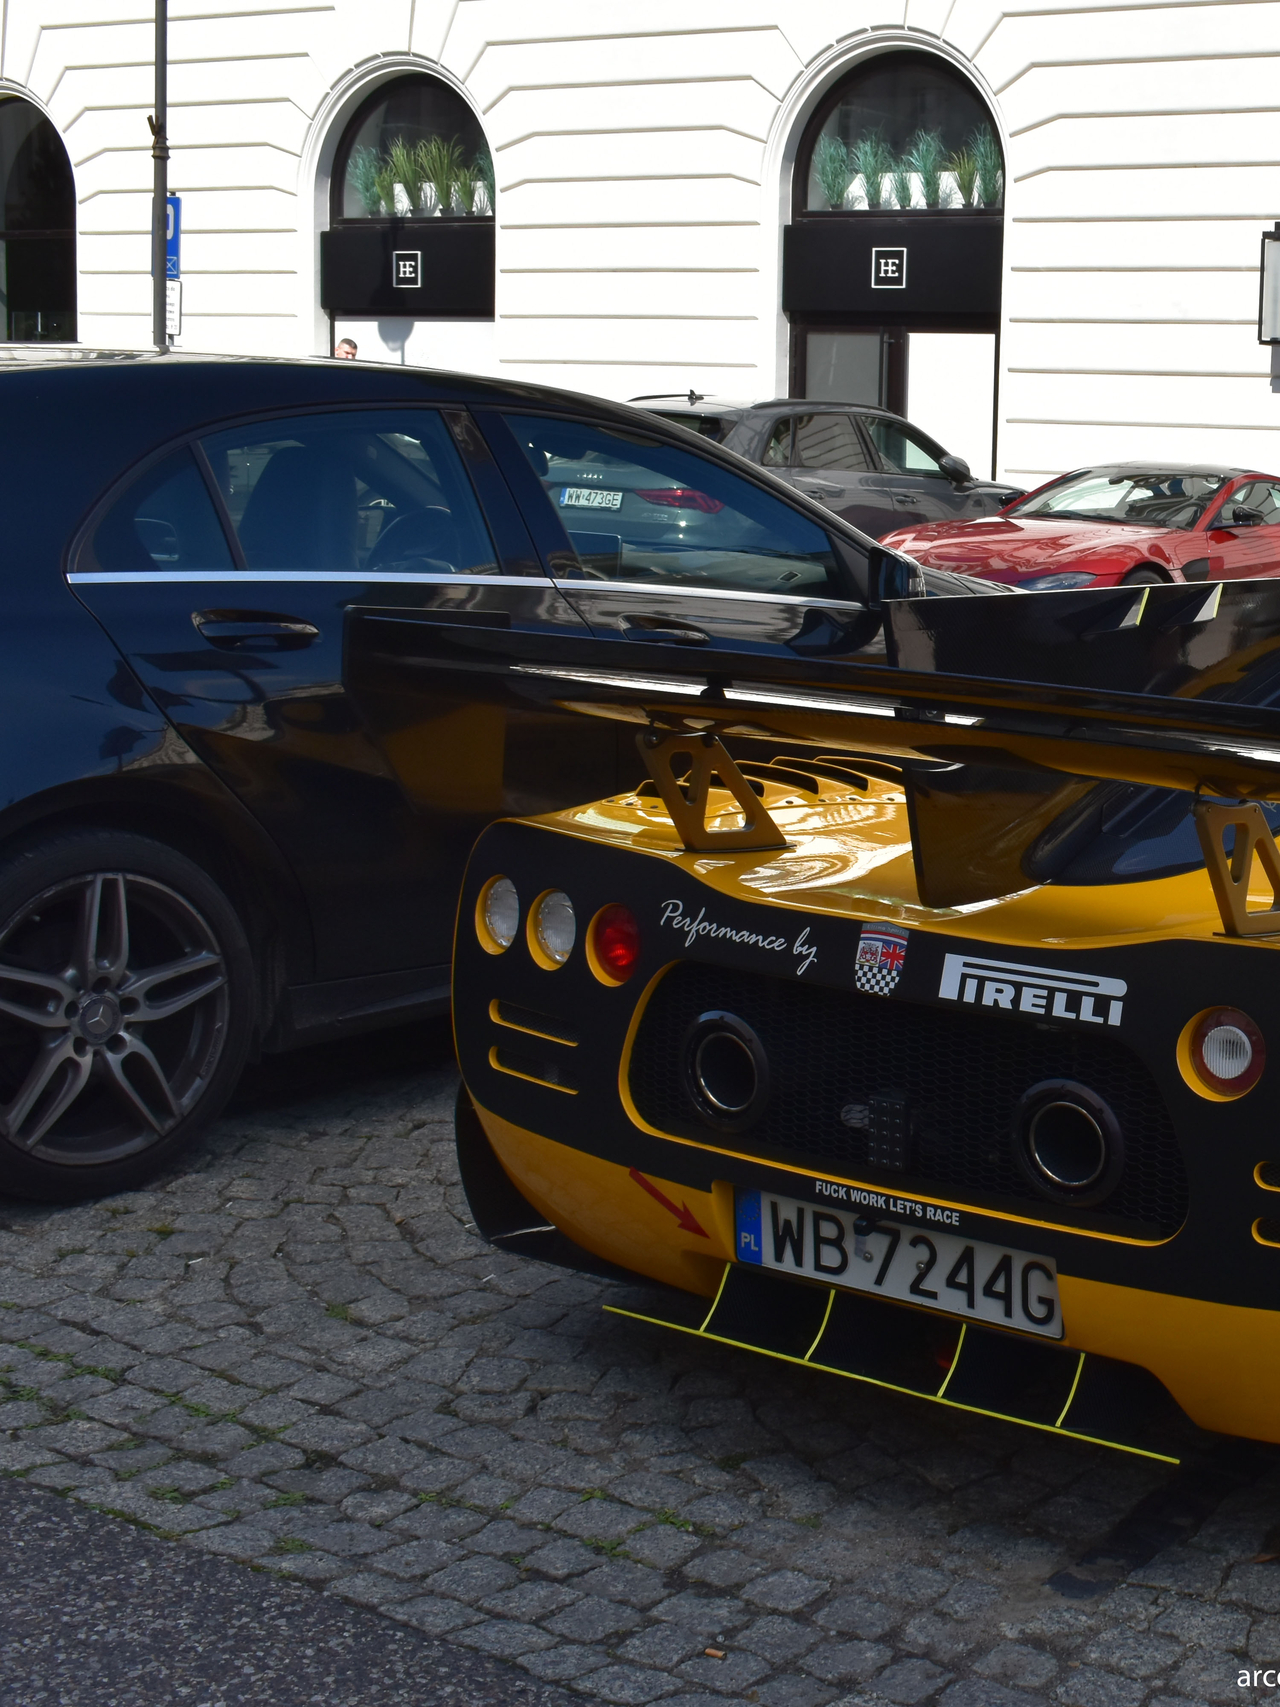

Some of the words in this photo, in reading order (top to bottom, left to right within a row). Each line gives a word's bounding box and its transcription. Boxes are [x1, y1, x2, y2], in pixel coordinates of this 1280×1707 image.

[398, 261, 416, 278] HE
[878, 259, 900, 277] HE
[567, 491, 582, 504] WW
[584, 491, 620, 507] 473GE
[660, 899, 788, 951] Performance
[792, 926, 818, 976] by
[938, 952, 1128, 1027] PIRELLI
[815, 1180, 848, 1200] FUCK
[850, 1189, 887, 1209] WORK
[889, 1198, 923, 1218] LET'S
[926, 1206, 960, 1226] RACE
[740, 1232, 759, 1251] PL
[770, 1200, 849, 1276] WB
[869, 1221, 1055, 1326] 7244G
